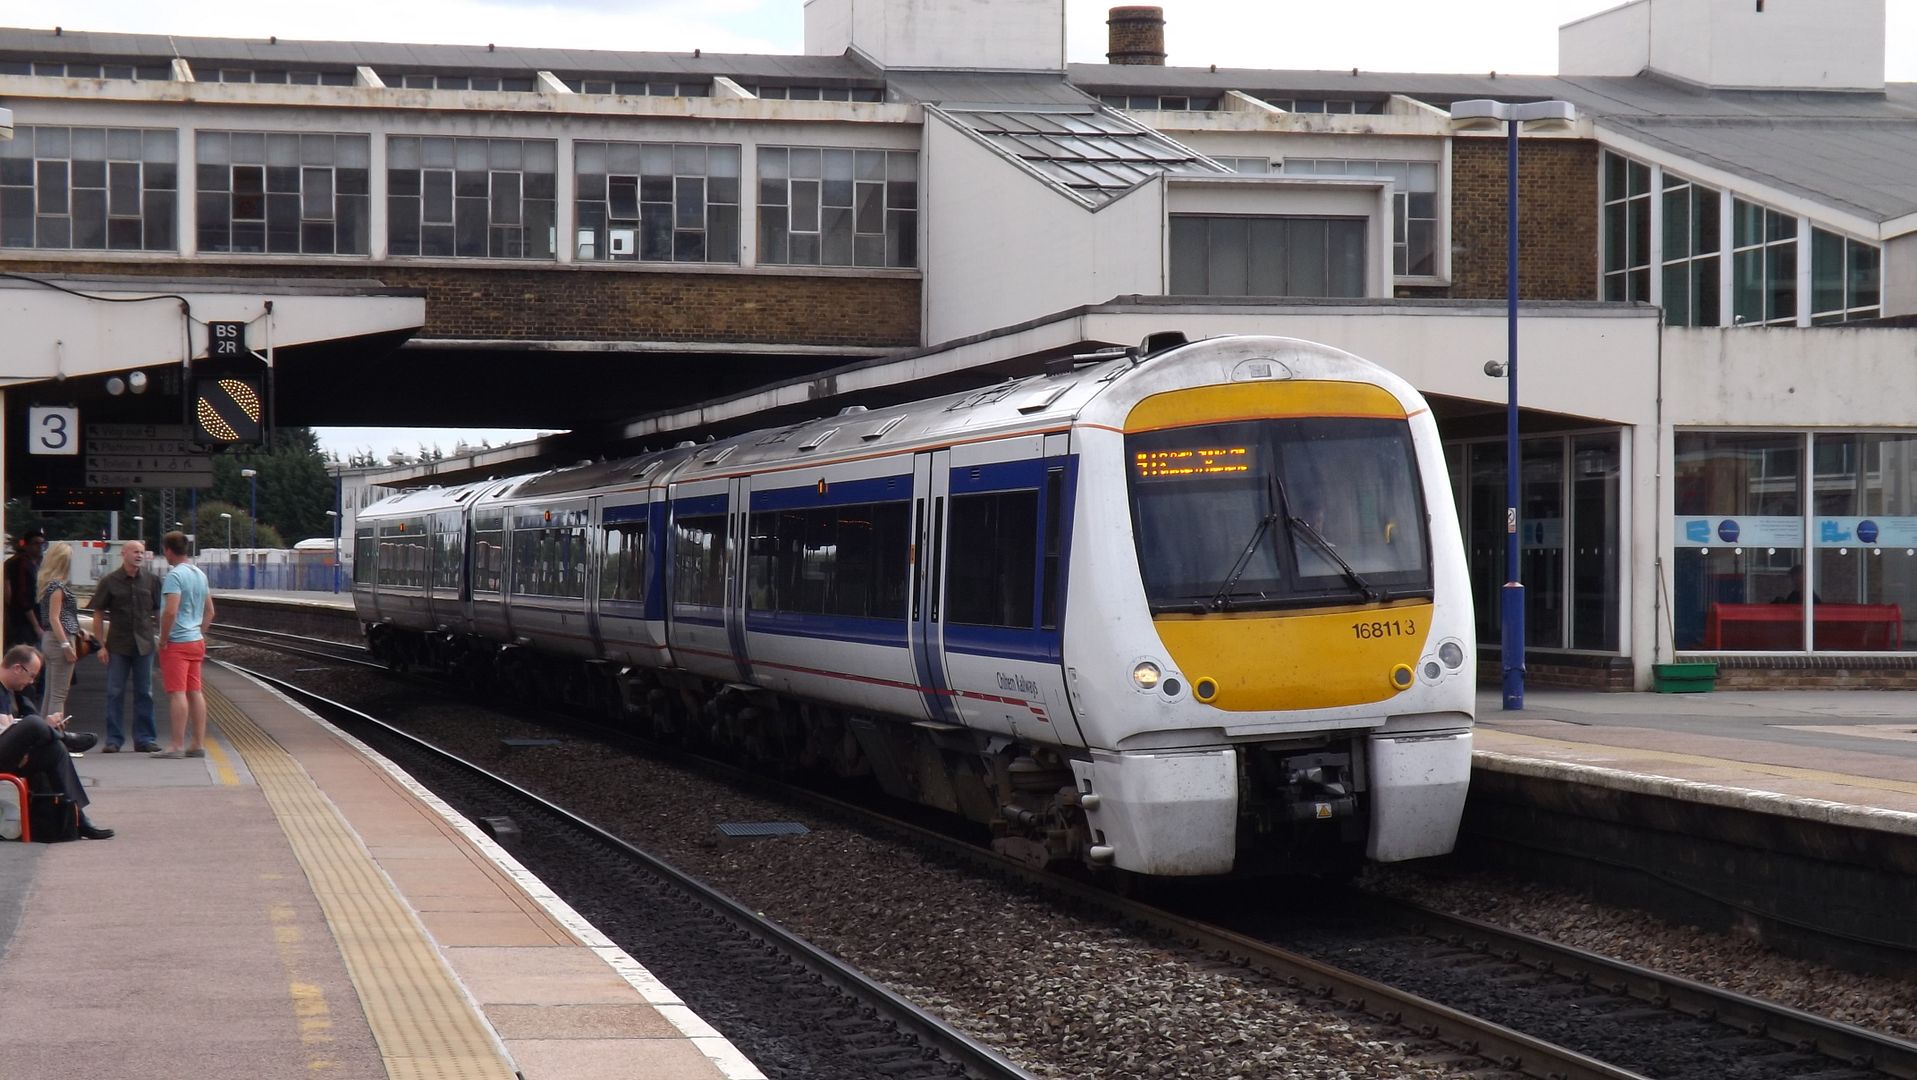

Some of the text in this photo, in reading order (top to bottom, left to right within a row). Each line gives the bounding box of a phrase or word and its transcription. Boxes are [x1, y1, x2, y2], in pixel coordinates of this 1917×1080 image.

[216, 325, 237, 337] BS
[217, 341, 237, 353] 2R
[41, 414, 67, 449] 3
[1352, 620, 1415, 639] 168113
